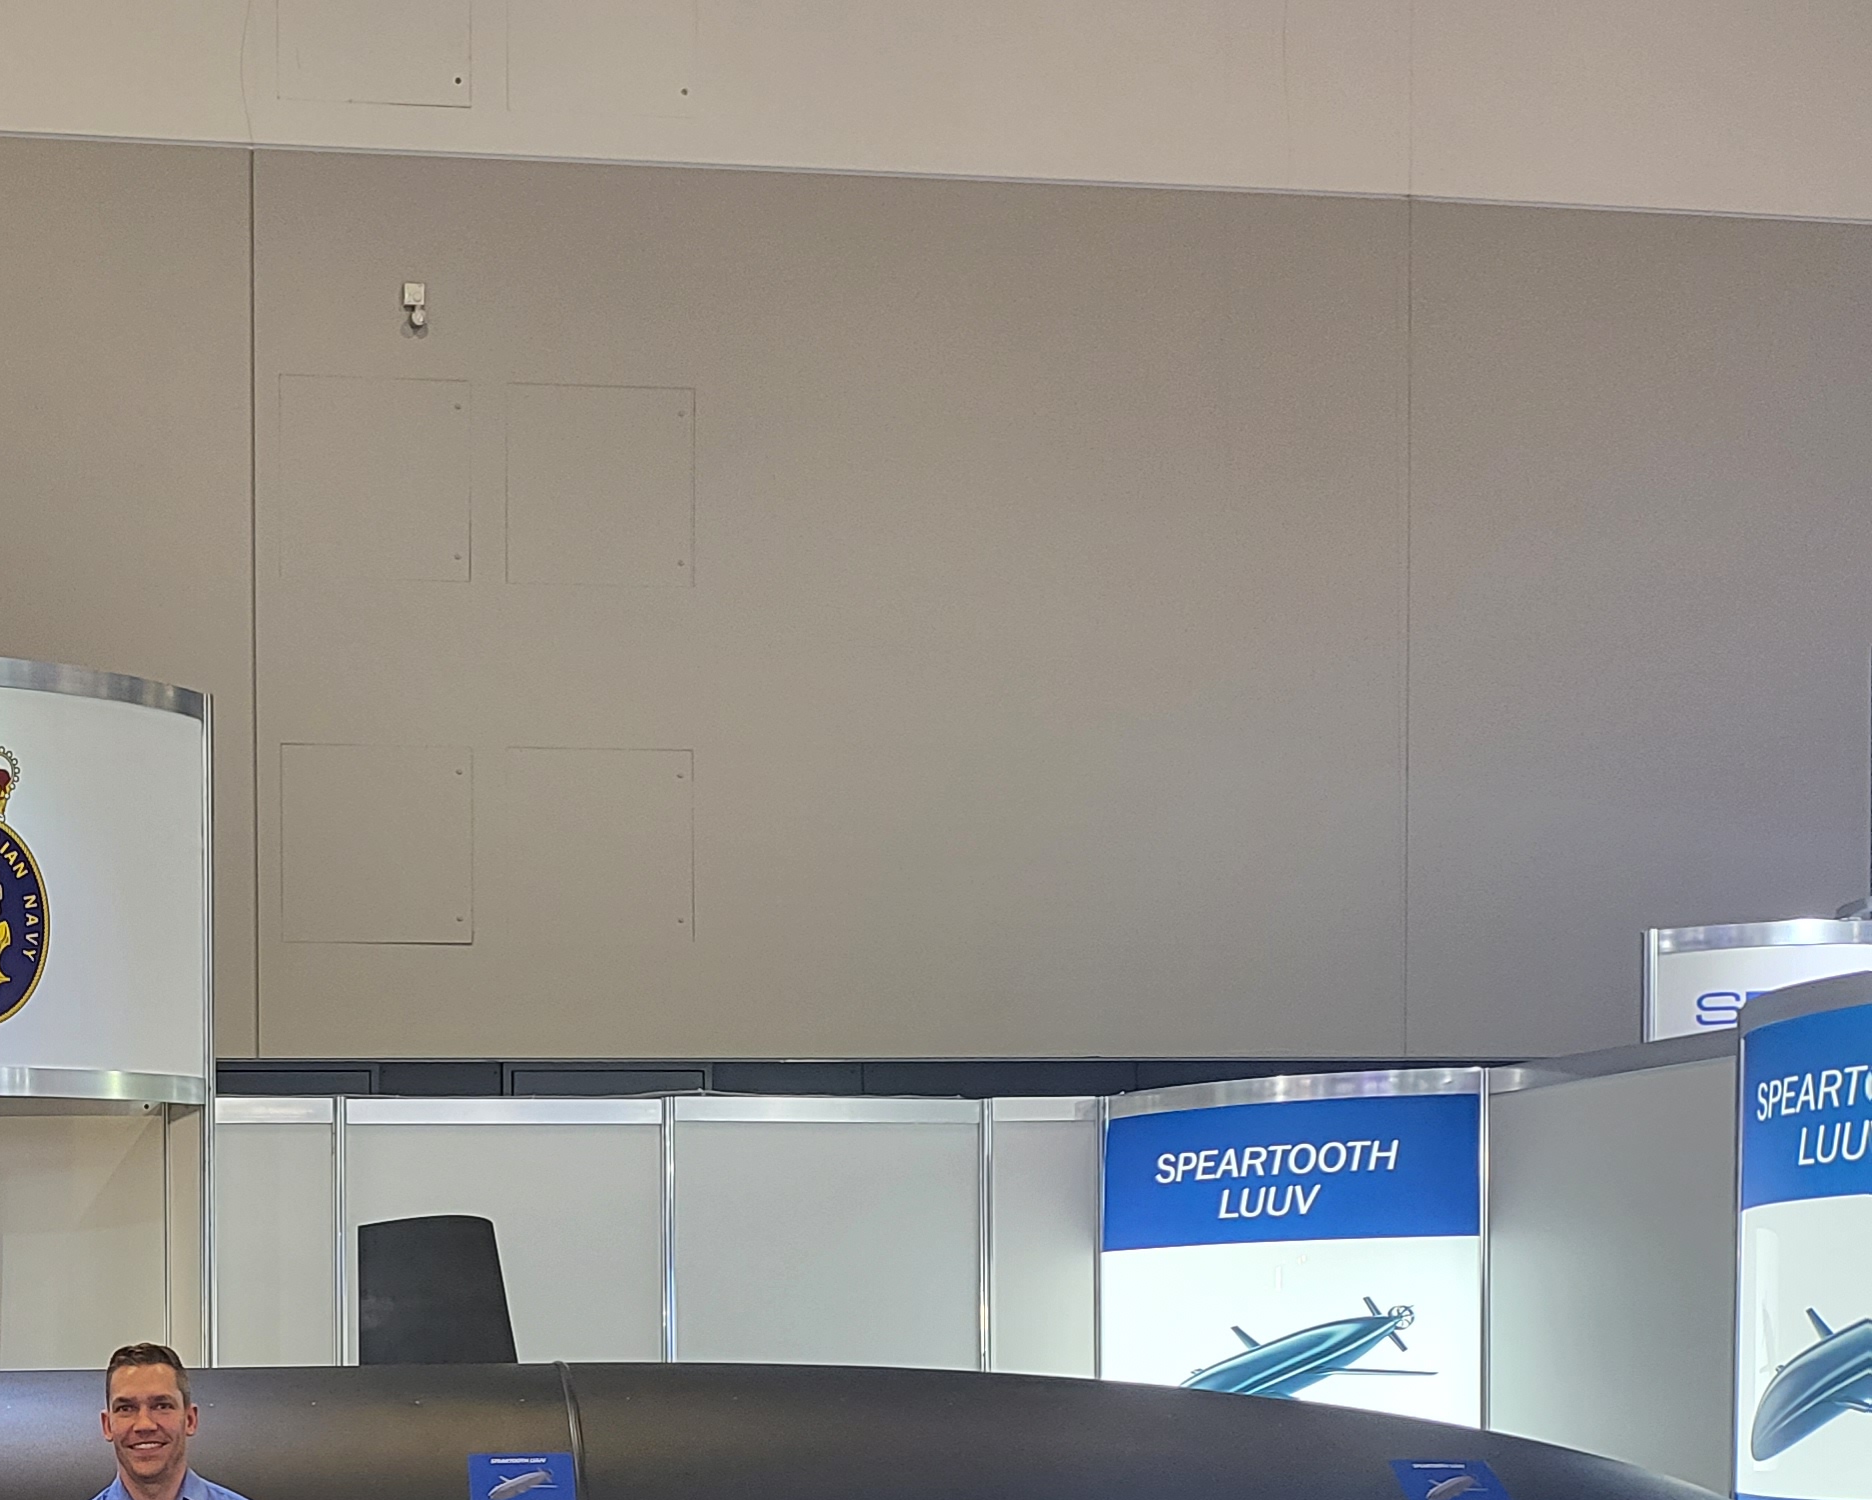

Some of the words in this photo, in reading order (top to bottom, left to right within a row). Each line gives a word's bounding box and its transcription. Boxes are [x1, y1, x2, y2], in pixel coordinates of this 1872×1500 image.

[23, 894, 39, 962] NAVY
[1155, 1139, 1399, 1183] SPEARTOOTH
[1798, 1119, 1872, 1166] LUU
[1218, 1184, 1322, 1219] LUUV
